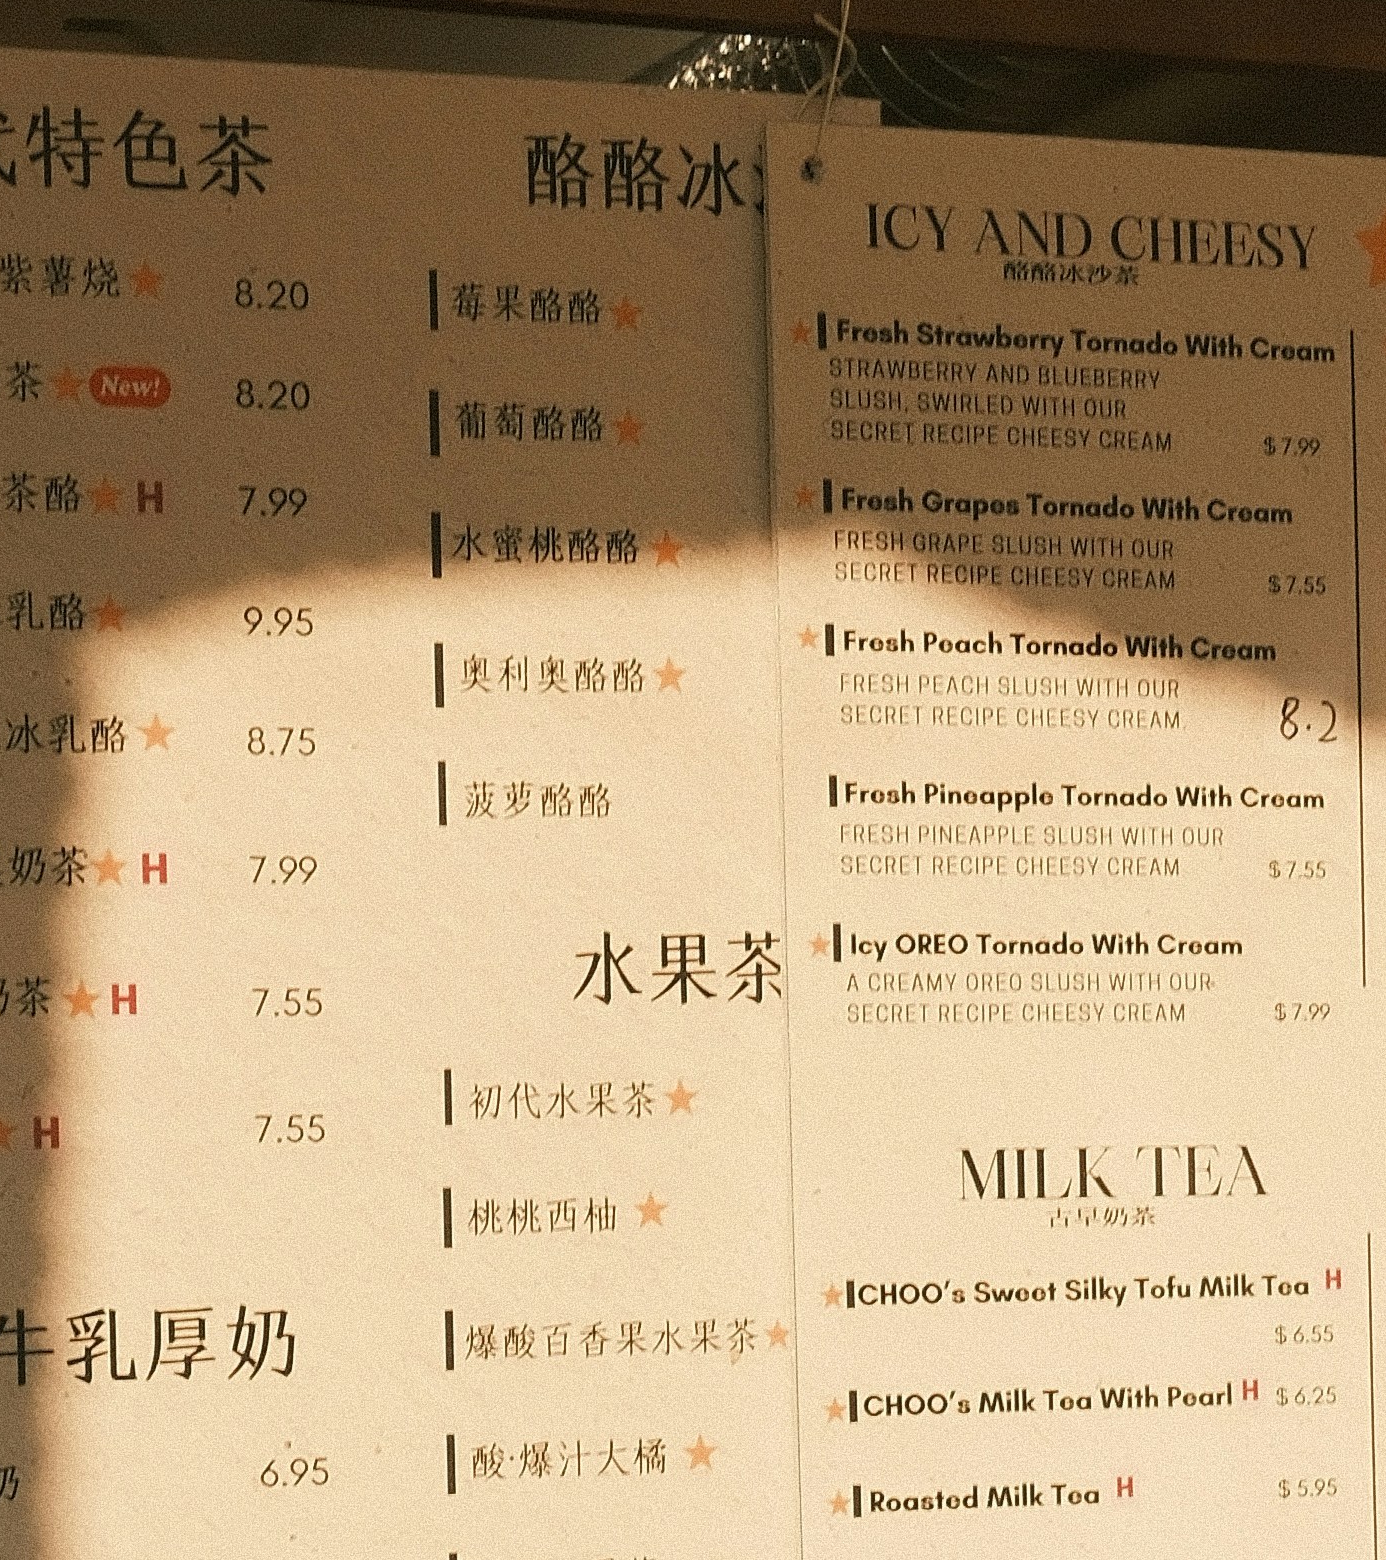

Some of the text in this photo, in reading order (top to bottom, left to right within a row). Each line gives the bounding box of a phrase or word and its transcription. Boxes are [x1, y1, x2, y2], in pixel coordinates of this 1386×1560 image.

[525, 132, 767, 223] 酪酪冰
[868, 203, 1316, 271] ICY AND CHEESY
[234, 278, 309, 311] 8.20
[454, 282, 601, 325] 莓果酪酪
[837, 318, 1335, 362] Fresh Strawberry Tornado With Cream
[101, 369, 165, 397] New!
[235, 379, 311, 411] 8.20
[829, 357, 1160, 389] STRAWBERRY AND BLUEBERRY
[457, 401, 603, 442] 葡萄酪酪
[137, 480, 163, 514] H
[239, 486, 308, 517] 7.99
[453, 524, 638, 565] 水蜜桃酪酪
[243, 606, 314, 637] 9.95
[247, 727, 316, 757] 8.75
[142, 853, 167, 884] H
[250, 856, 318, 884] 7.99
[851, 932, 1243, 962] Icy OREO Tornado With Cream
[575, 931, 781, 1005] 水果茶
[112, 984, 137, 1015] H
[253, 988, 323, 1017] 7.55
[472, 1081, 653, 1119] 初代水果茶
[33, 1116, 60, 1149] H
[256, 1114, 325, 1143] 7.55
[962, 1146, 1266, 1199] MILK TEA
[469, 1197, 616, 1235] 桃桃西柚
[260, 1458, 329, 1487] 6.95
